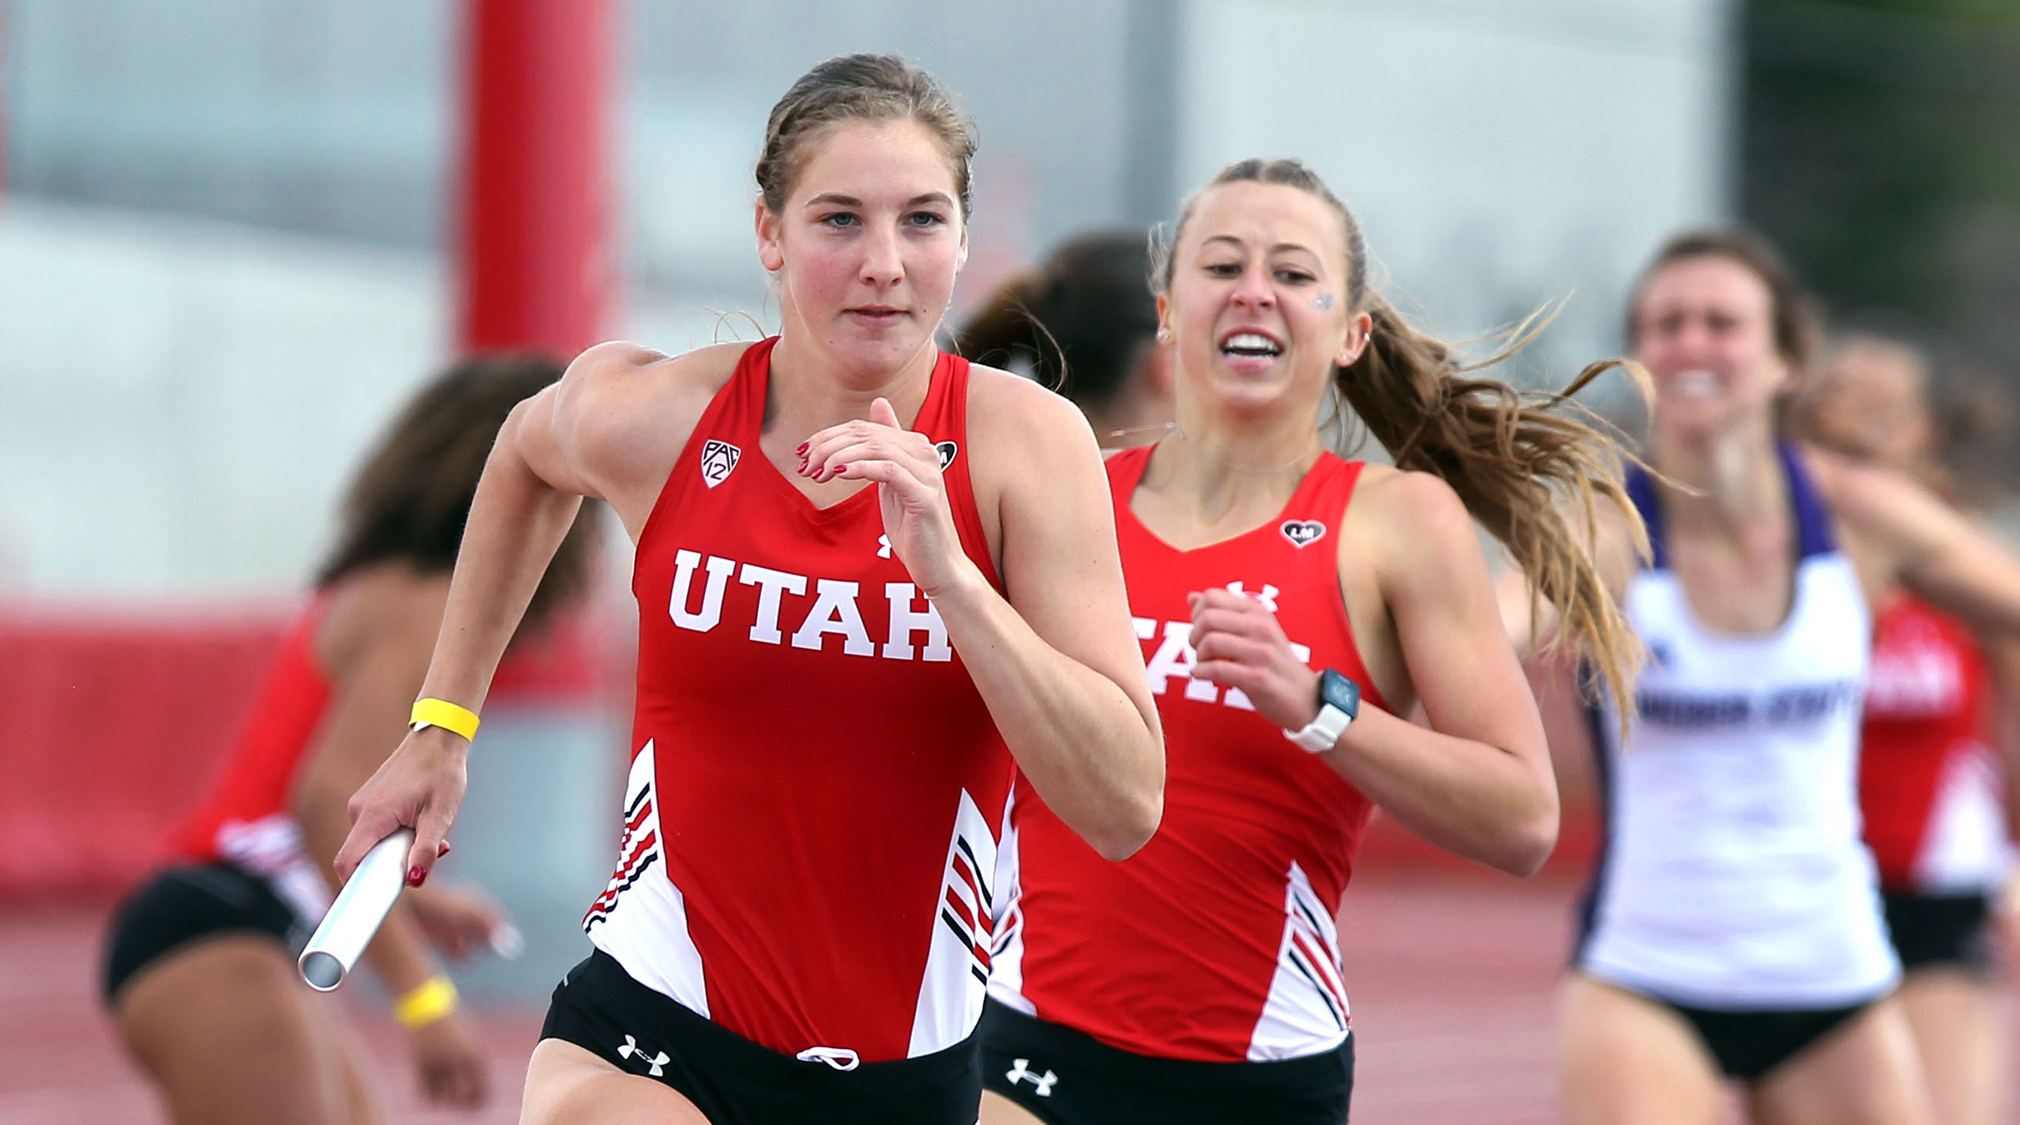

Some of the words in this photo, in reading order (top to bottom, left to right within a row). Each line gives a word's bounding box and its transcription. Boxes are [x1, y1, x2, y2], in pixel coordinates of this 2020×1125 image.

[703, 441, 740, 473] PAC
[705, 461, 727, 481] 12
[668, 548, 953, 662] UTAH
